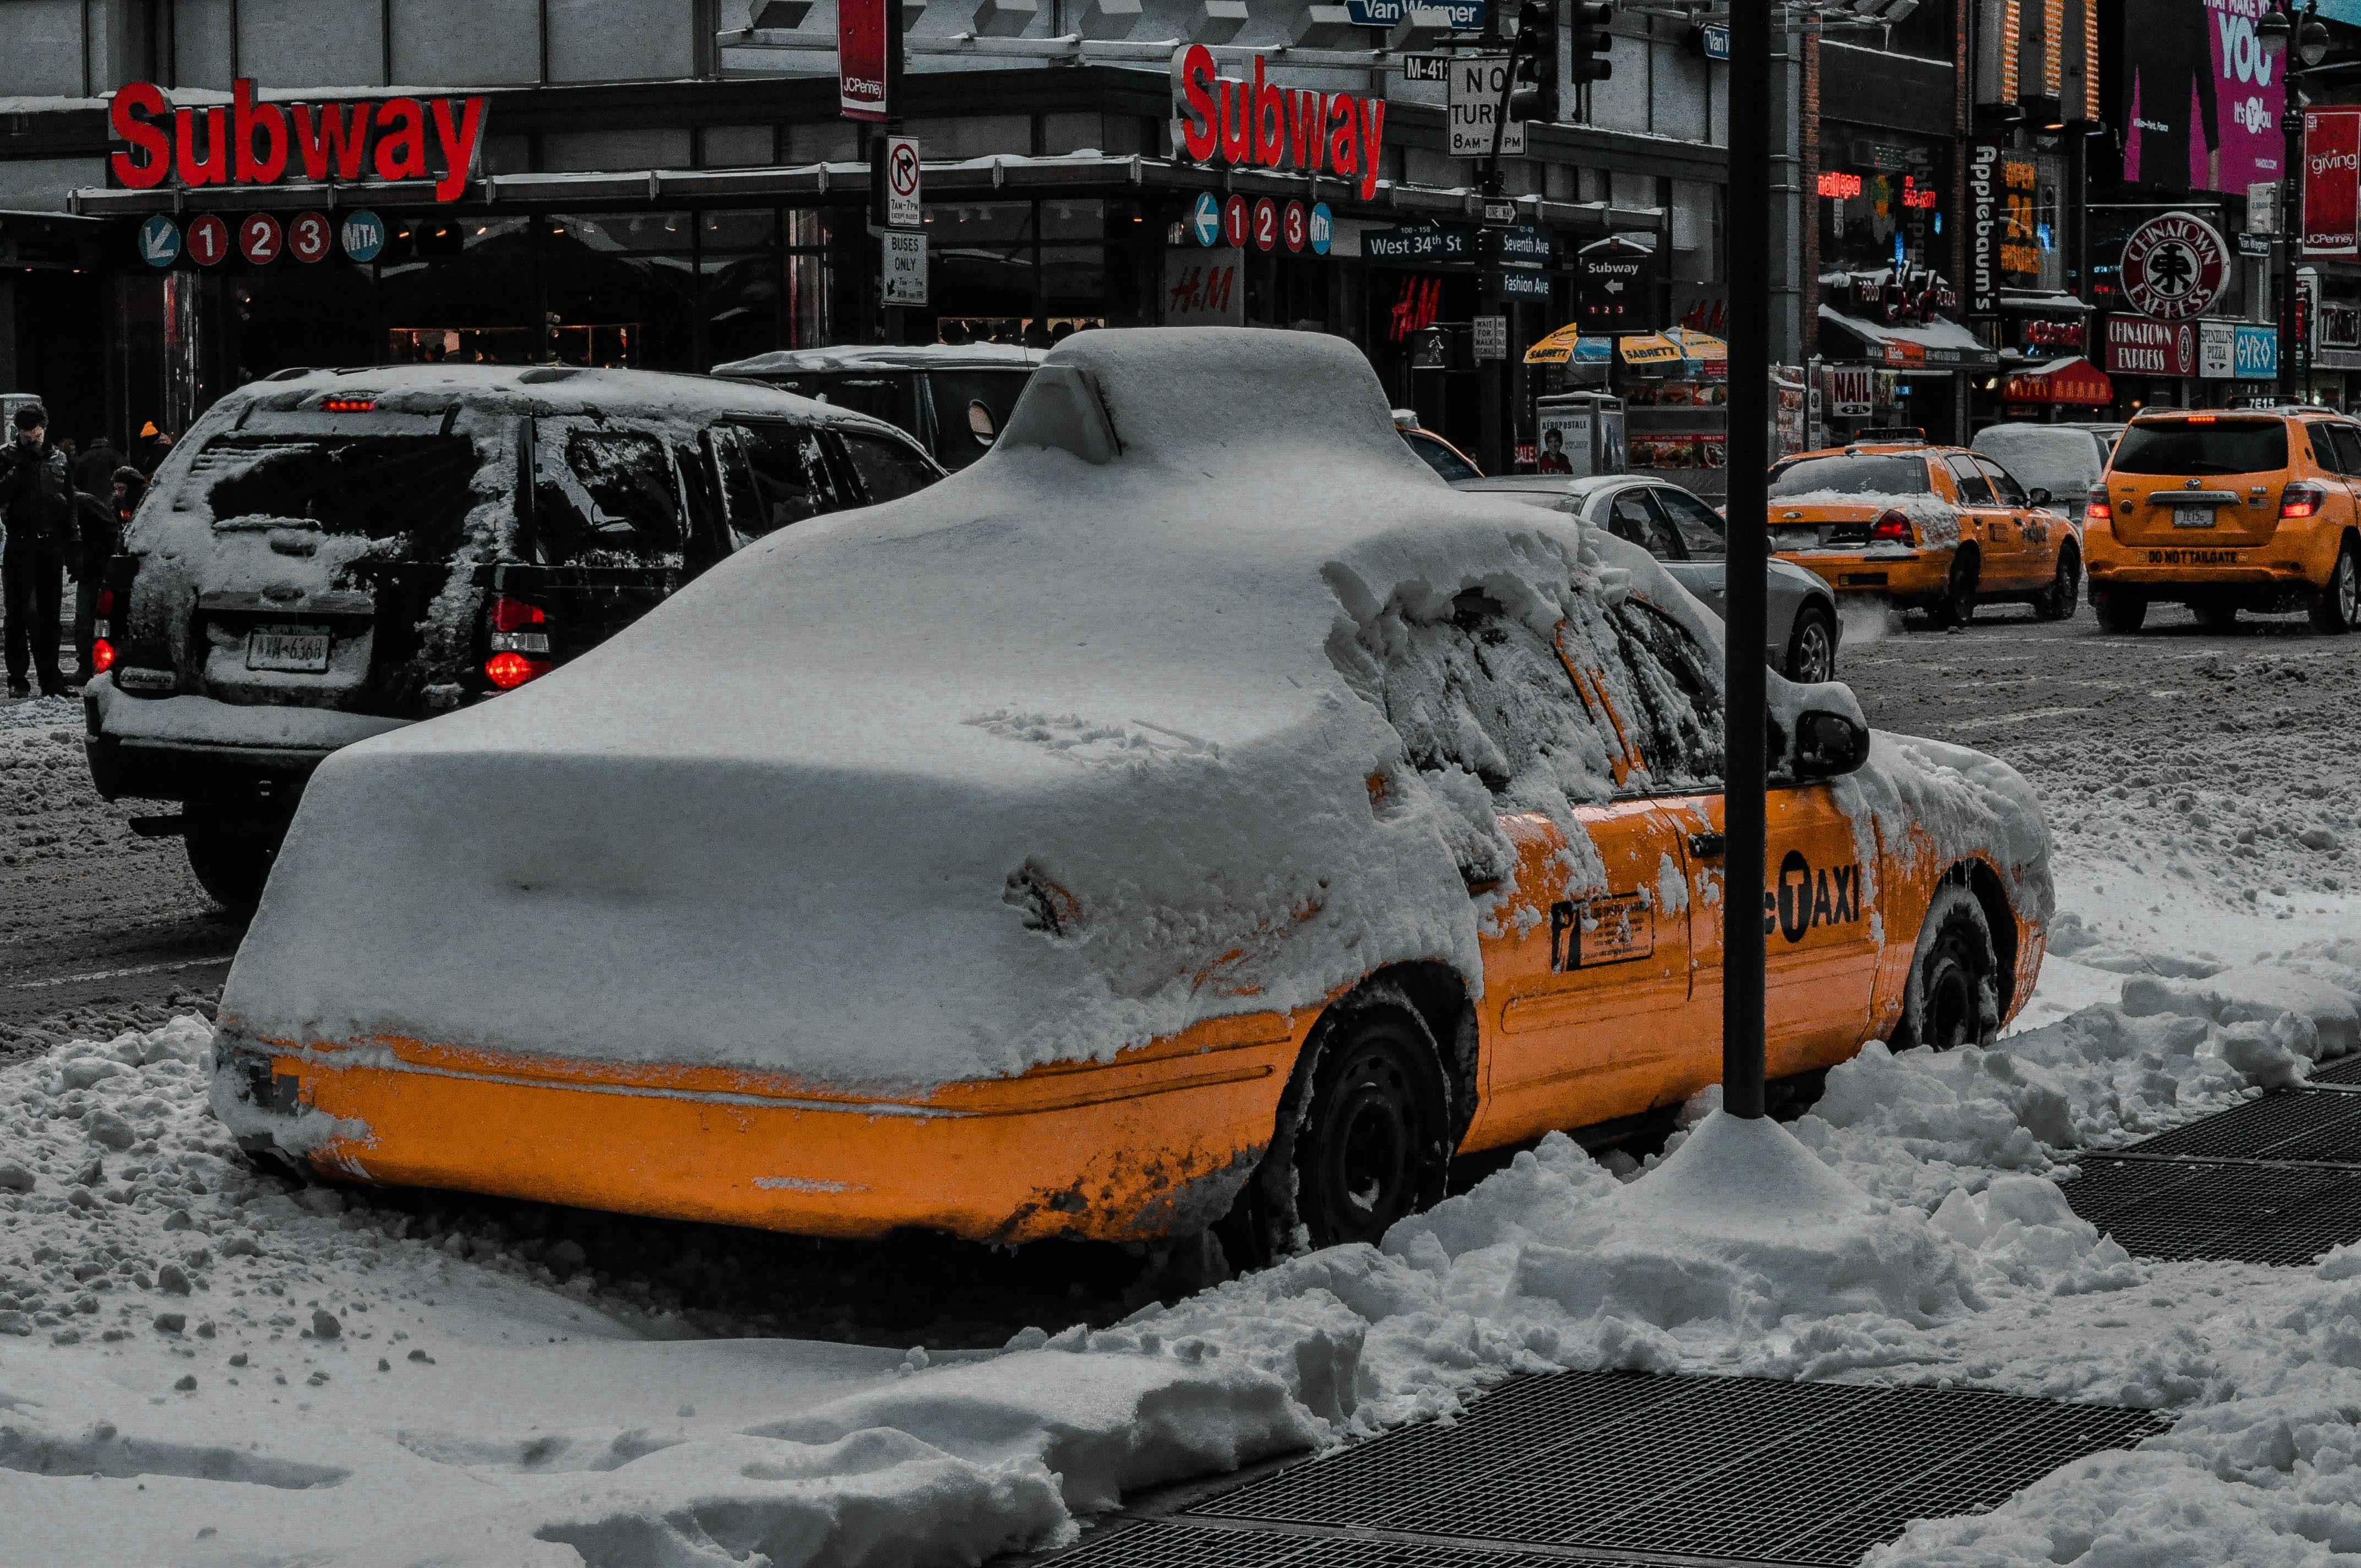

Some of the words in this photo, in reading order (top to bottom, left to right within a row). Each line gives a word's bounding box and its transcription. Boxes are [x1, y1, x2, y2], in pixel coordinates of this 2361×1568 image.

[1364, 0, 1399, 18] Van
[2228, 0, 2256, 18] MAKE
[1407, 57, 1448, 79] M-41
[844, 77, 883, 98] JCPenney
[1466, 66, 1508, 93] NO
[1182, 43, 1386, 202] Subway
[111, 78, 485, 202] Subway
[2311, 149, 2358, 173] giving
[890, 199, 918, 211] 7AM-7PM
[1232, 204, 1241, 239] 1
[1260, 206, 1272, 242] 2
[1290, 208, 1302, 243] 3
[1310, 212, 1329, 242] MTA
[199, 224, 213, 257] 1
[251, 221, 271, 255] 2
[300, 220, 321, 254] 3
[341, 221, 378, 253] MTA
[891, 237, 919, 252] BUSES
[1370, 238, 1410, 255] West
[1413, 234, 1441, 253] 34th
[1446, 235, 1462, 252] St
[1504, 234, 1533, 253] Seventh
[1535, 237, 1549, 254] Ave
[2129, 220, 2219, 265] CHINATOWN
[2306, 234, 2354, 245] JCPenney
[895, 257, 916, 271] ONLY
[1588, 263, 1639, 275] Subway
[1171, 266, 1234, 313] H&M
[1504, 275, 1533, 293] Fashion
[1534, 278, 1549, 294] Ave
[1862, 285, 1880, 301] FOOD
[2129, 282, 2212, 319] EXPRESS
[2109, 320, 2172, 345] CHINATOWN
[1625, 346, 1675, 359] SABRETT
[2118, 347, 2164, 371] EXPRESS
[2208, 345, 2226, 360] PIZZA
[2237, 334, 2270, 369] GYRO
[1834, 372, 1870, 402] NAIL
[2249, 398, 2275, 409] 7E15
[2149, 551, 2162, 564] DO
[2164, 551, 2188, 564] NOT
[2190, 551, 2238, 564] TAILGATE
[1781, 857, 1859, 937] TAXI
